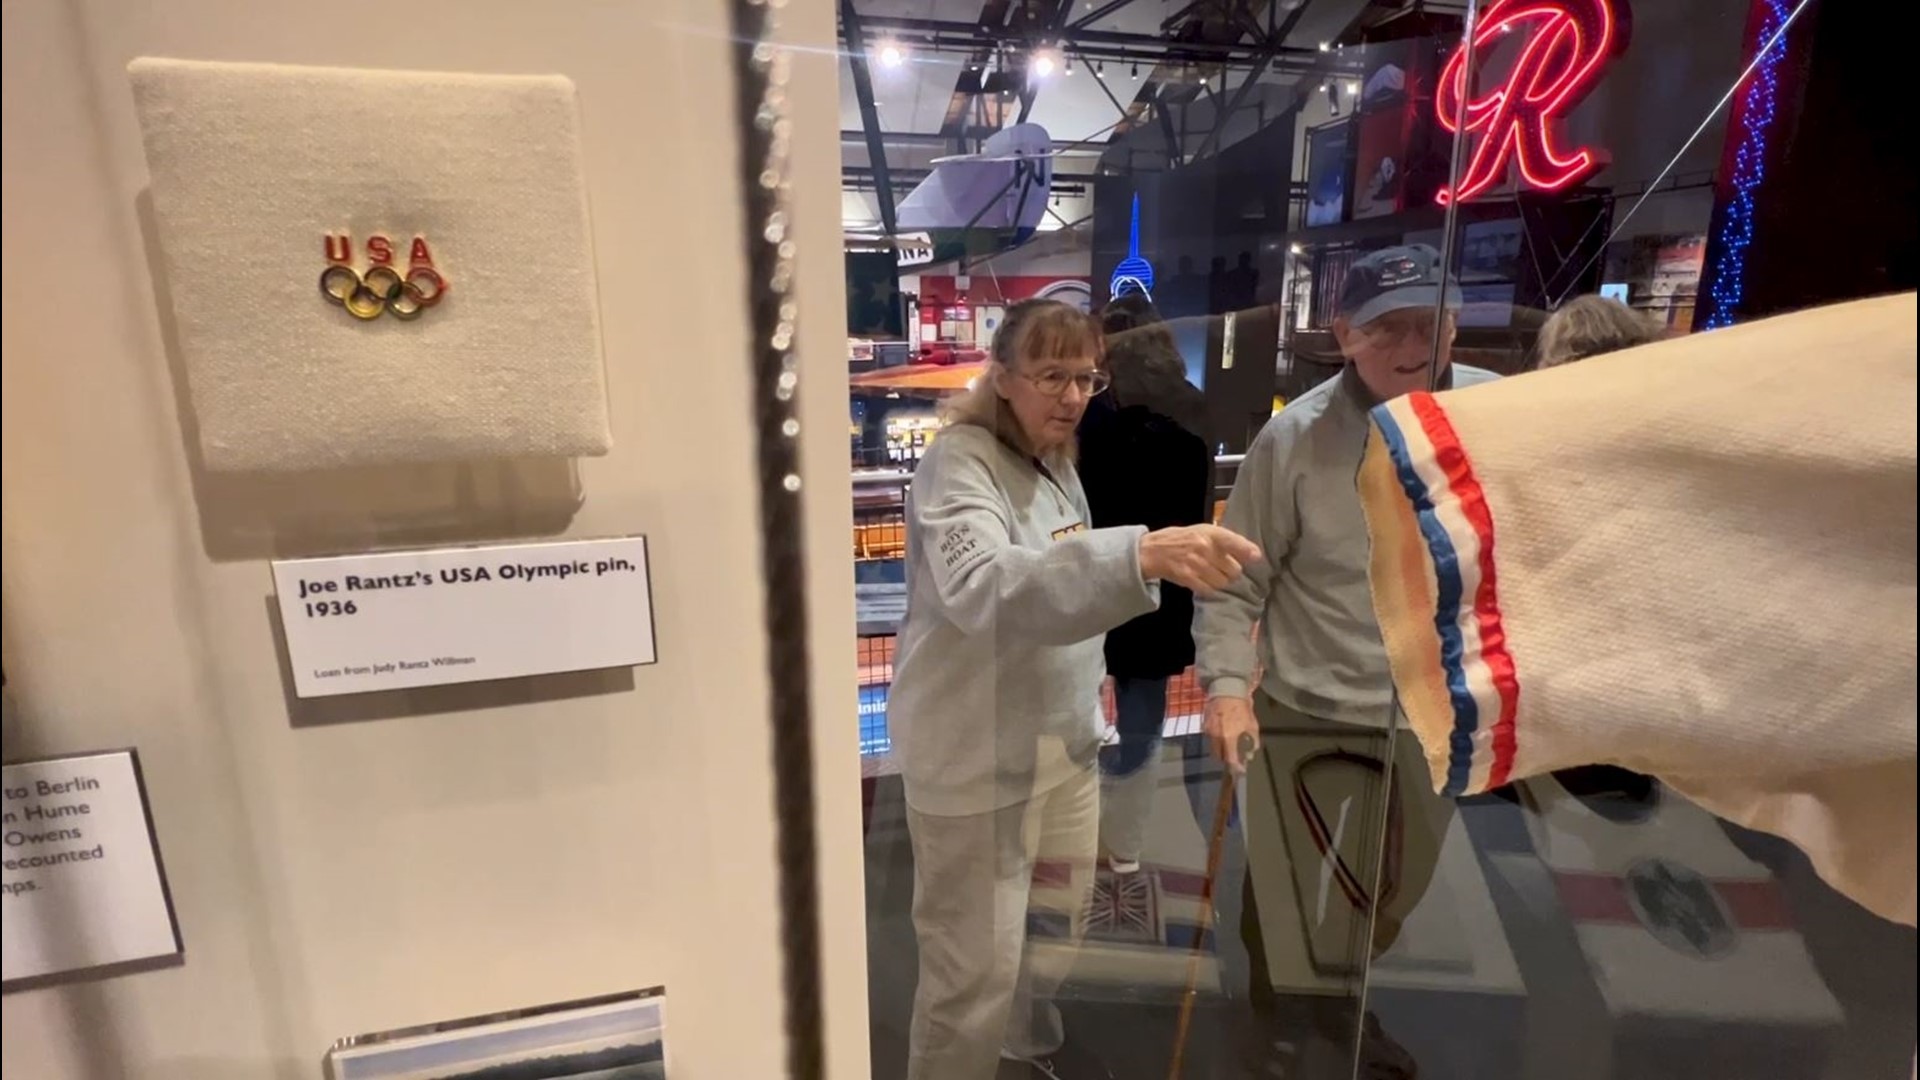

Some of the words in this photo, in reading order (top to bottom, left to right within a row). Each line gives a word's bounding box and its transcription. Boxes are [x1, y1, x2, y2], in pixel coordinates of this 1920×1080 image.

[1435, 0, 1612, 205] R
[323, 232, 435, 267] USA
[945, 538, 978, 567] BOAT
[299, 579, 339, 598] Joe
[440, 565, 493, 584] USA
[498, 560, 590, 582] Olympic
[596, 557, 637, 577] pin,
[305, 600, 358, 618] 1936
[313, 669, 342, 679] Loan
[344, 666, 372, 676] from
[373, 663, 396, 676] Judy
[398, 660, 430, 671] Rantz
[5, 787, 29, 800] to
[35, 776, 101, 797] Berlin
[23, 803, 92, 822] Hume
[4, 827, 82, 847] Owens
[2, 843, 104, 871] ecounted
